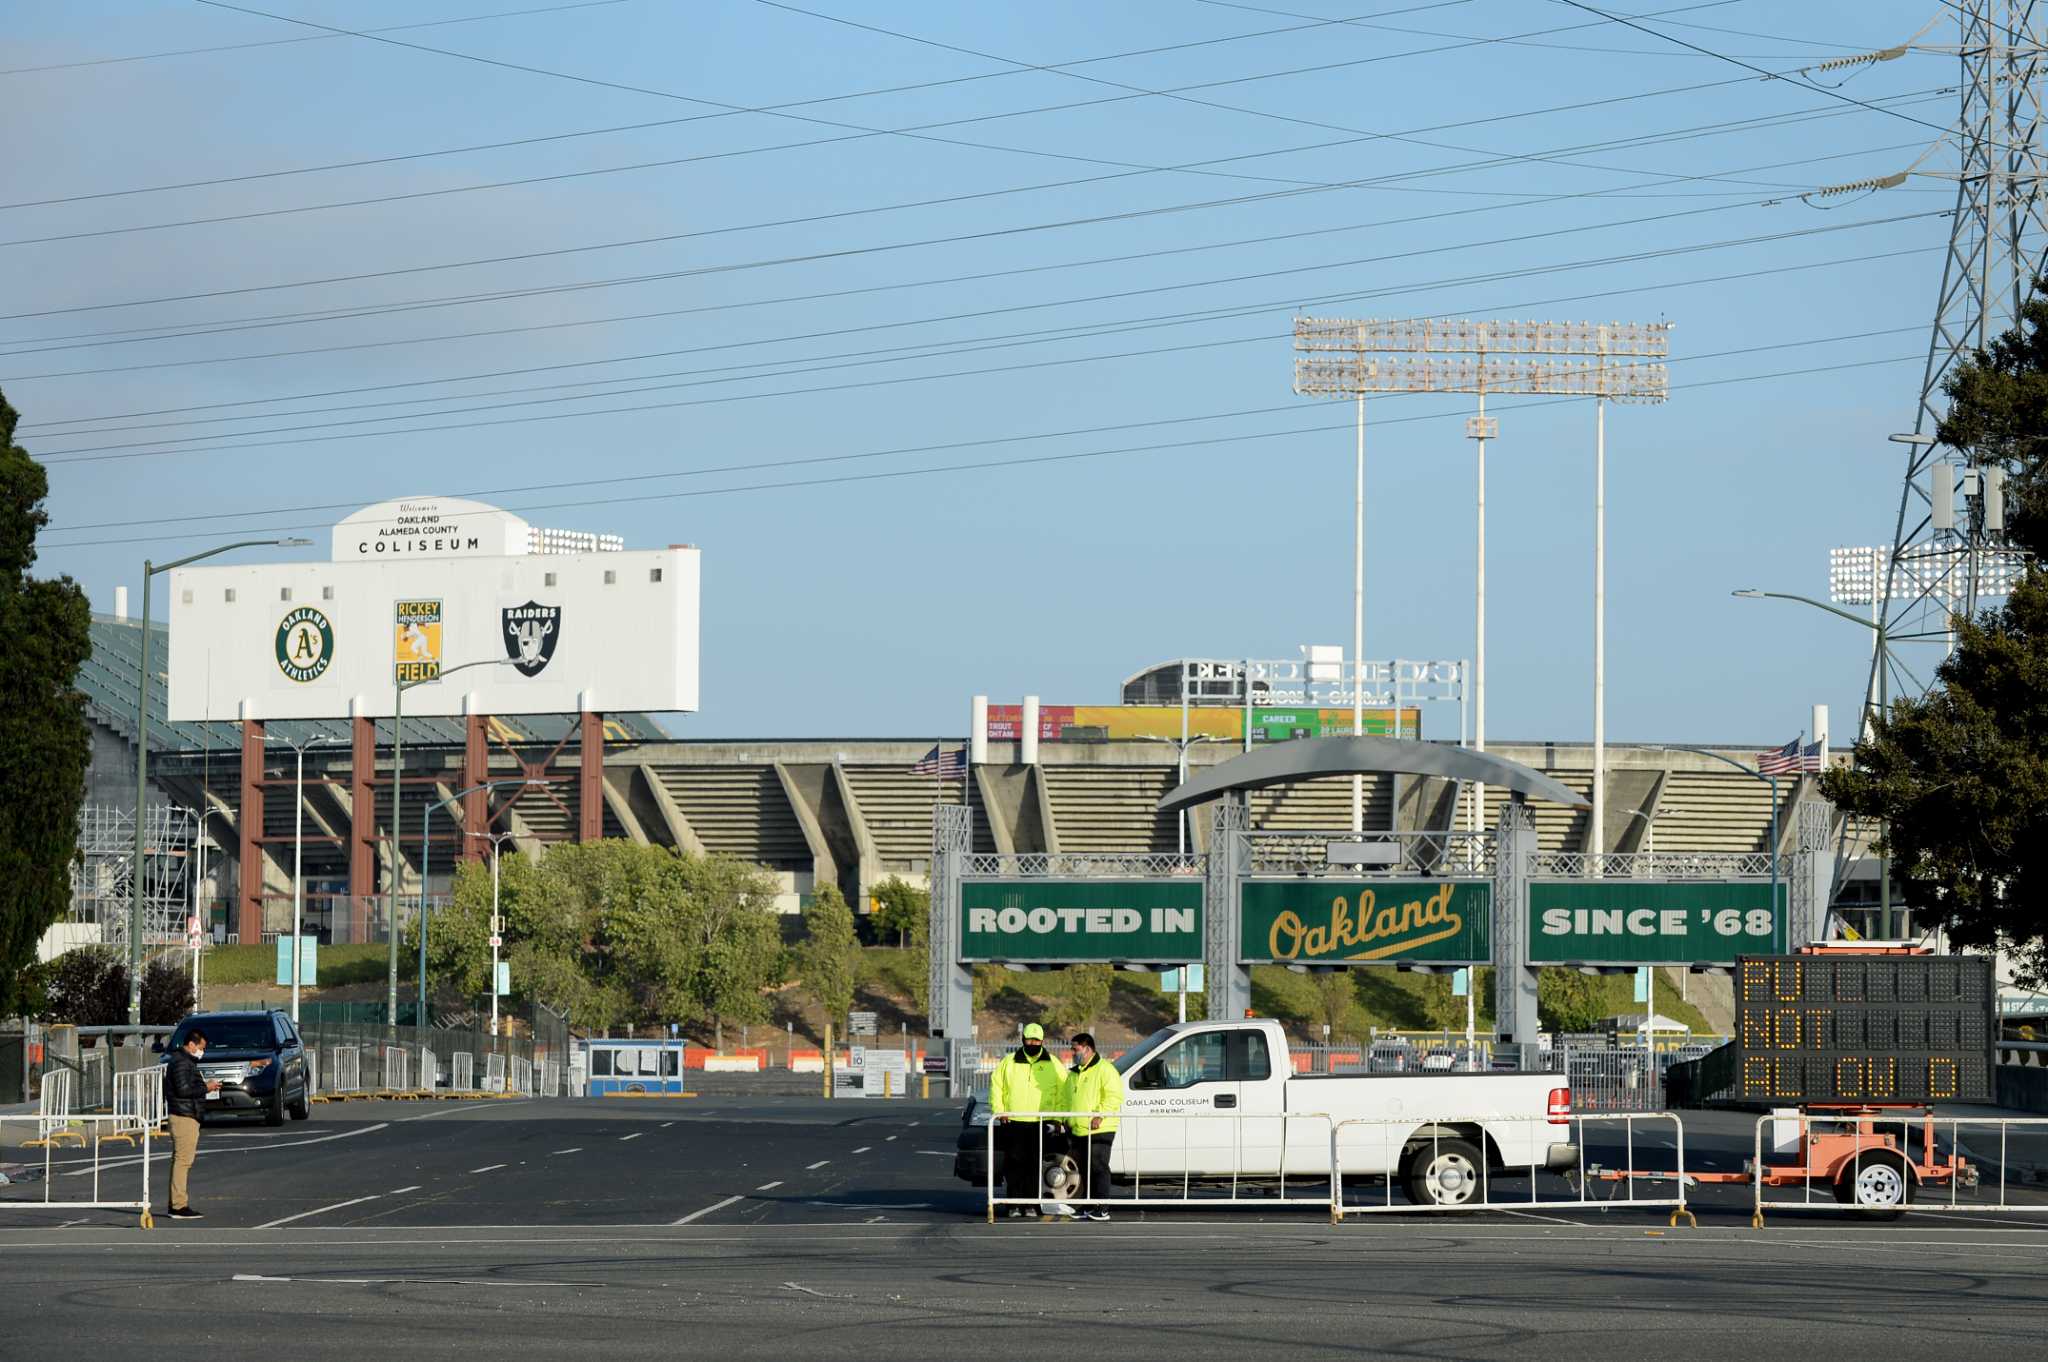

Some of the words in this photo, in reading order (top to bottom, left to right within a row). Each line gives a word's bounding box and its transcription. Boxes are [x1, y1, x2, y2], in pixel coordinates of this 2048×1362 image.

[397, 515, 440, 525] OAKLAND
[378, 527, 420, 537] ALAMEDA
[422, 525, 458, 535] COUNTY
[359, 537, 479, 554] COLISEUM
[398, 602, 438, 615] RICKEY
[507, 607, 556, 619] RAIDERS
[282, 608, 328, 631] OAKLAND
[398, 614, 440, 623] HENDERSON
[280, 656, 328, 681] ATHLETICS
[397, 663, 438, 680] FIELD
[988, 722, 1012, 730] TROUT
[1263, 715, 1296, 723] CAREER
[969, 907, 1142, 934] ROOTED
[1151, 908, 1195, 933] IN
[1269, 883, 1462, 960] Oakland
[1541, 908, 1688, 936] SINCE
[1701, 908, 1773, 936] '68
[1743, 1008, 1833, 1050] NOT
[1126, 1099, 1167, 1107] OAKLAND
[1169, 1098, 1209, 1106] COLISEUM
